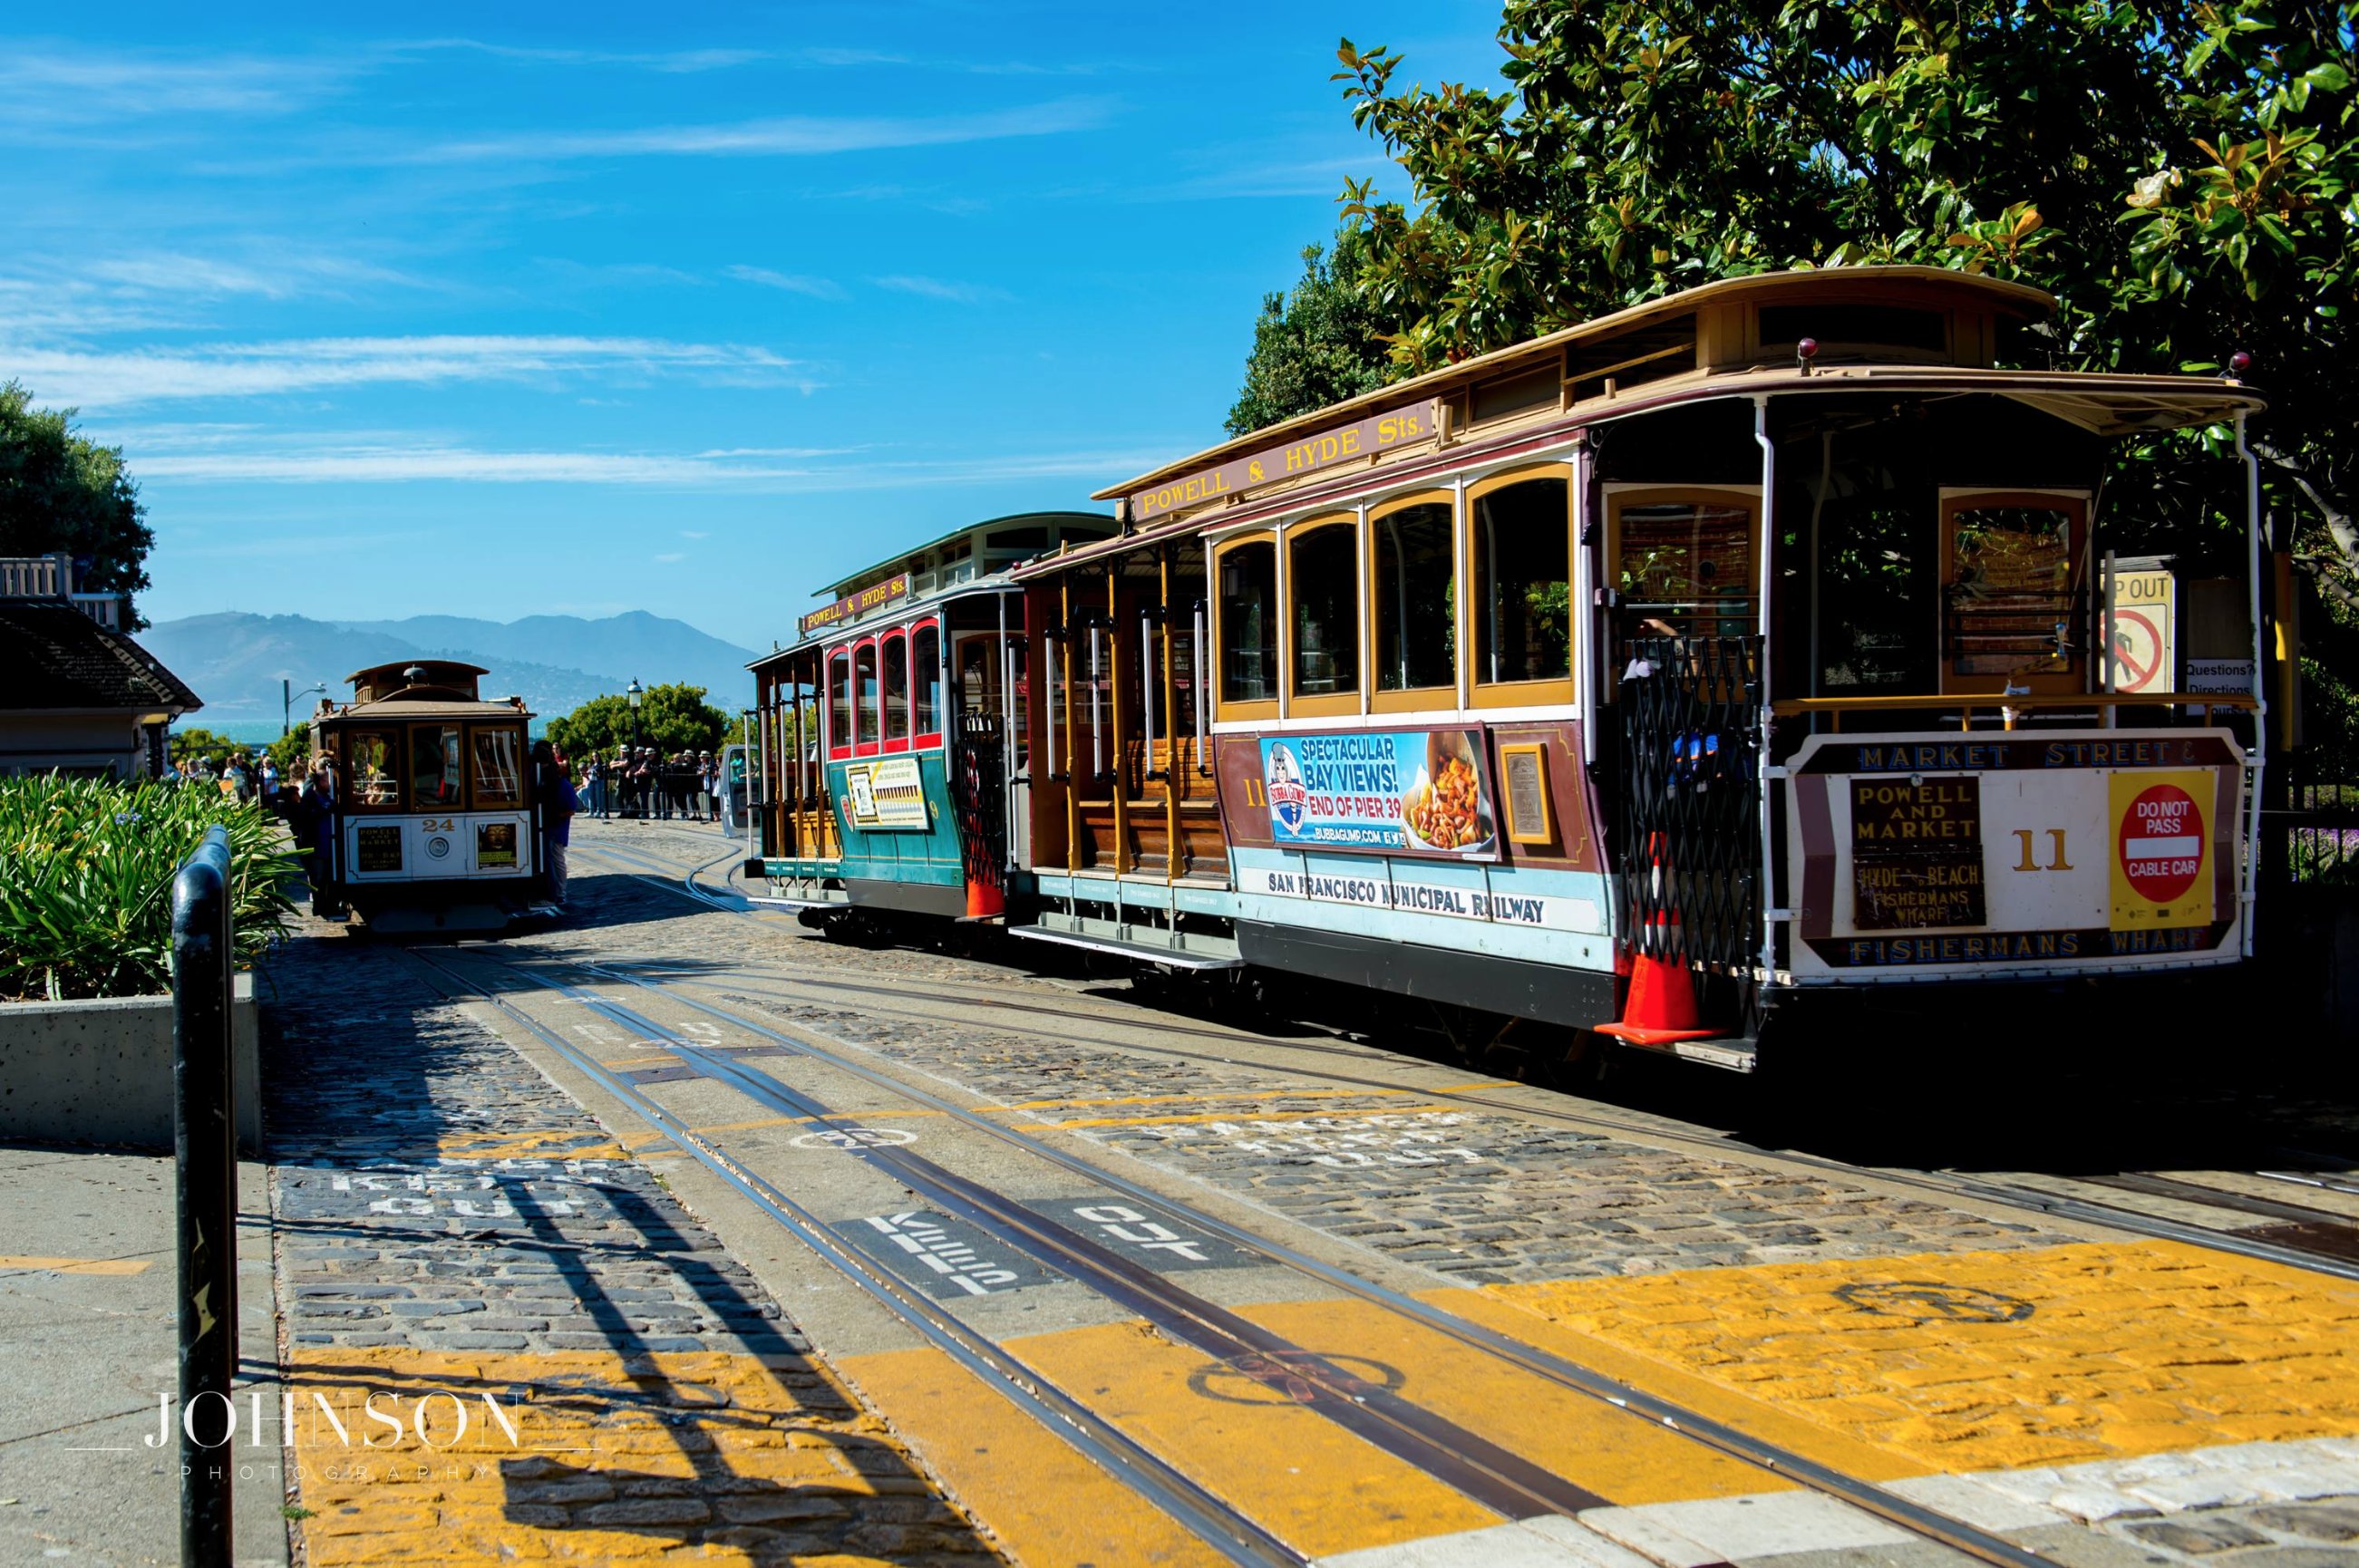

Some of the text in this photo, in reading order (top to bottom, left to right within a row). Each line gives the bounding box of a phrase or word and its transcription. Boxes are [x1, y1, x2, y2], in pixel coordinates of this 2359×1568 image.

[1142, 416, 1424, 514] POWELL & HYDE Sts.
[808, 580, 905, 628] POWELL & HYDE Sts.
[2187, 663, 2255, 677] Questions?
[1301, 738, 1394, 760] SPECTACULAR
[1859, 744, 2010, 769] MARKET
[2045, 740, 2170, 767] STREET
[1304, 764, 1399, 793] BAY VIEWS!
[1244, 779, 1267, 807] 11
[1859, 785, 1972, 805] POWELL
[929, 800, 938, 819] 9
[1308, 796, 1401, 818] END OF PIER 39
[1890, 805, 1946, 819] AND
[2138, 801, 2189, 817] DO NOT
[422, 818, 455, 832] 24
[1315, 828, 1382, 844] BUBBAGUMP.COM
[1859, 820, 1976, 839] MARKET
[2146, 818, 2181, 834] PASS
[2012, 828, 2074, 871] 11
[1860, 867, 1902, 887] HYDE
[1927, 865, 1978, 886] BEACH
[2129, 860, 2197, 877] CABLE CAR
[1268, 873, 1295, 893] SAN
[1298, 876, 1376, 903] FRANCISCO
[1849, 927, 2204, 964] FISHERMANS WHARF
[1073, 1205, 1210, 1262] OUT
